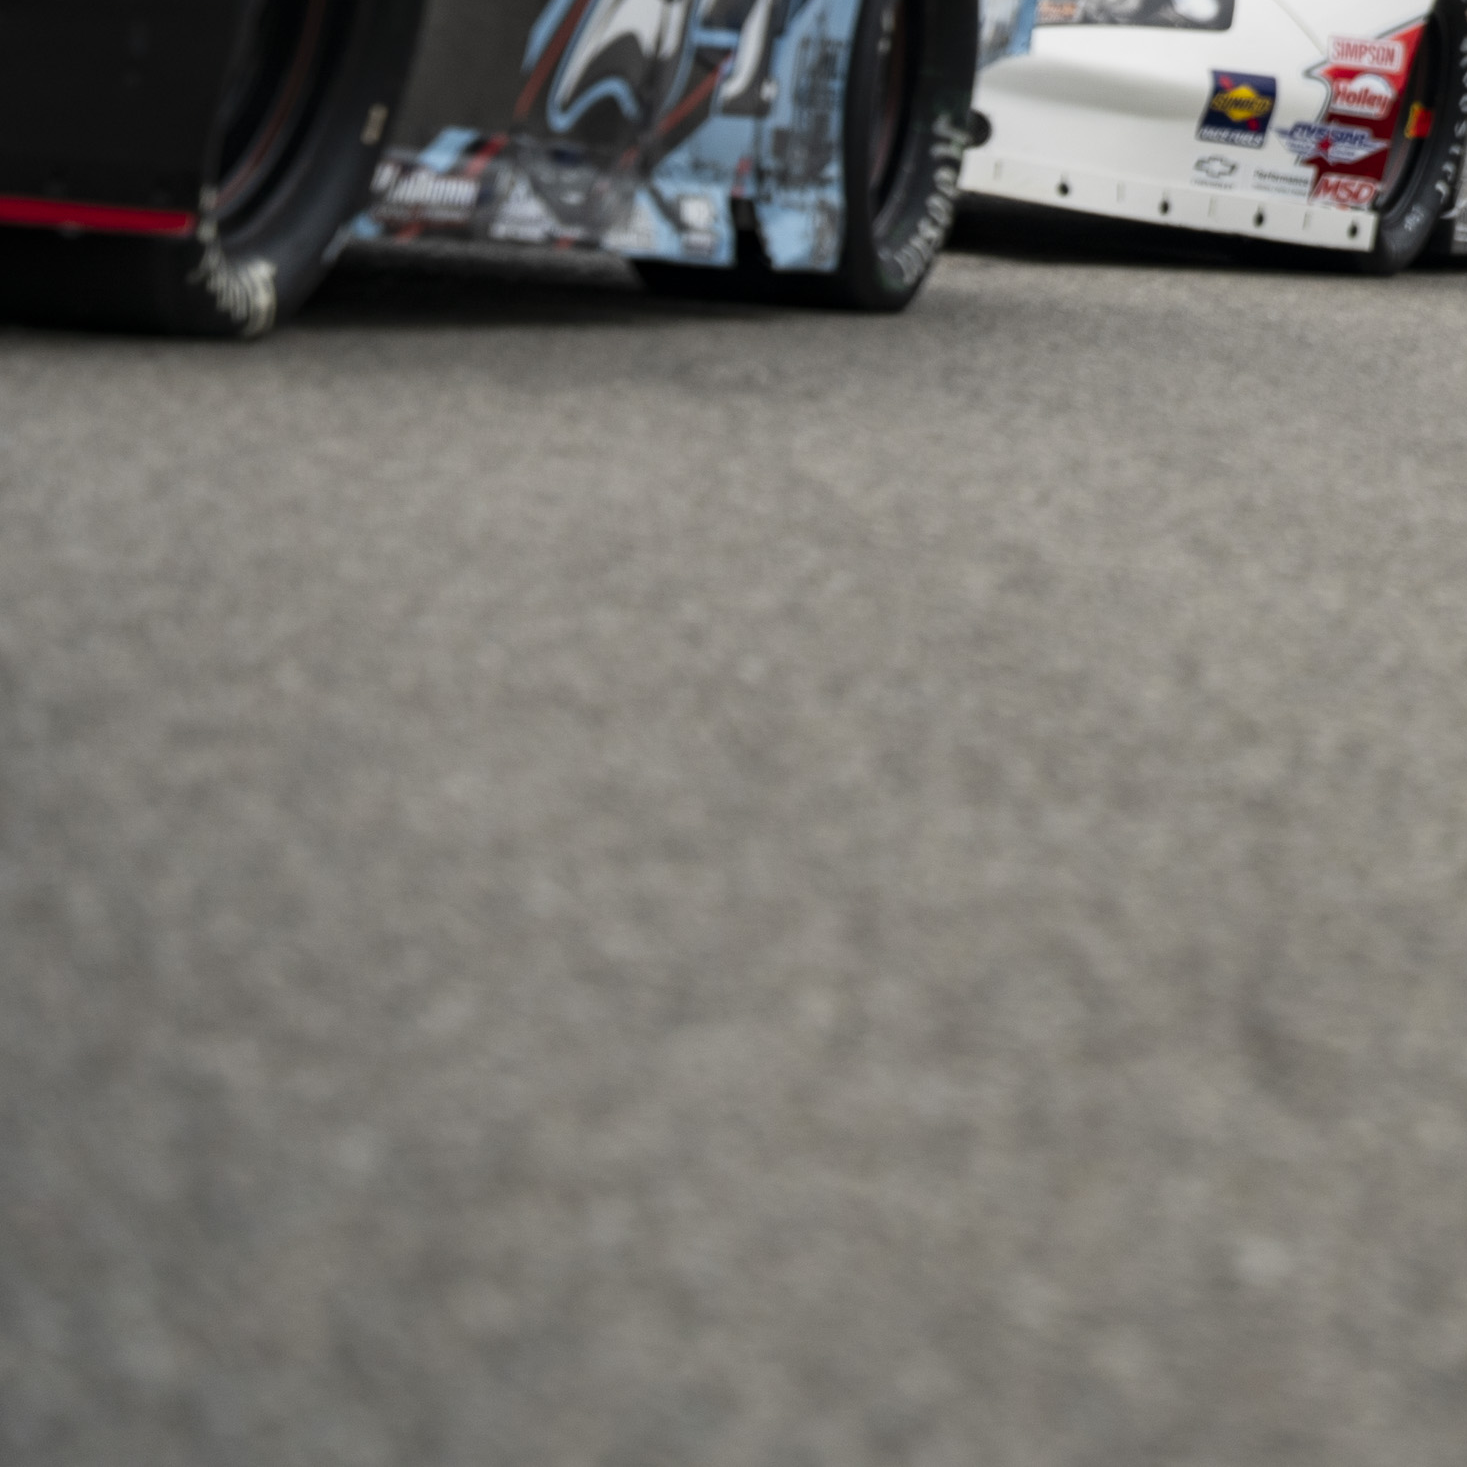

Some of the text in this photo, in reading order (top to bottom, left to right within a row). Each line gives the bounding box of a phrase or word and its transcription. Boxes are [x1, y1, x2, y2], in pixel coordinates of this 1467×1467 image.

[1333, 41, 1396, 66] SIMPSON
[1212, 92, 1272, 114] SUNOCO
[1332, 79, 1392, 114] Holley
[1318, 176, 1376, 202] MSD
